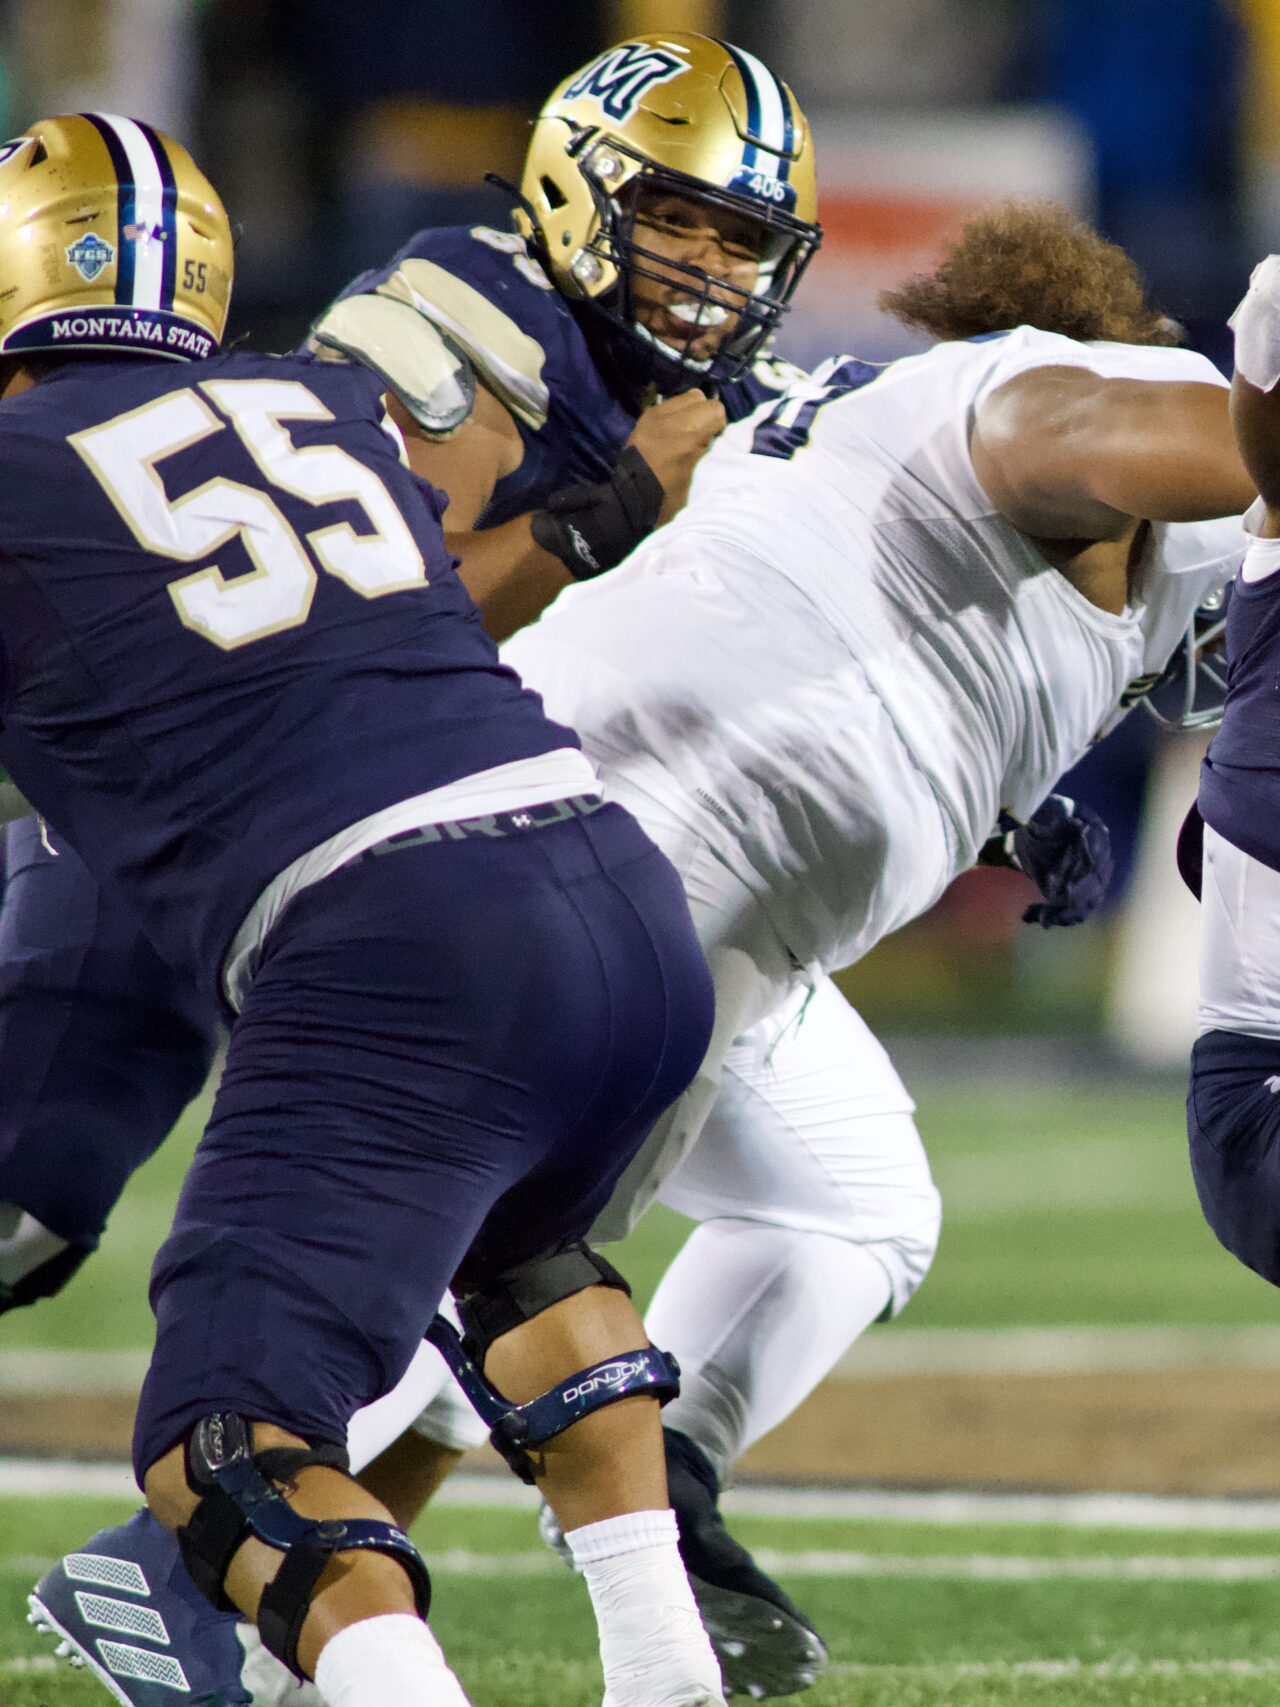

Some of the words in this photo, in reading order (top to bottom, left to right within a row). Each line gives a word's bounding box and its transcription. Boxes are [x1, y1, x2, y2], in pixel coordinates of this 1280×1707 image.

[748, 174, 785, 202] 406
[183, 259, 207, 293] 55
[52, 318, 164, 343] MONTANA
[166, 326, 212, 358] STATE
[66, 378, 429, 651] 55
[562, 1359, 644, 1404] DONJOY
